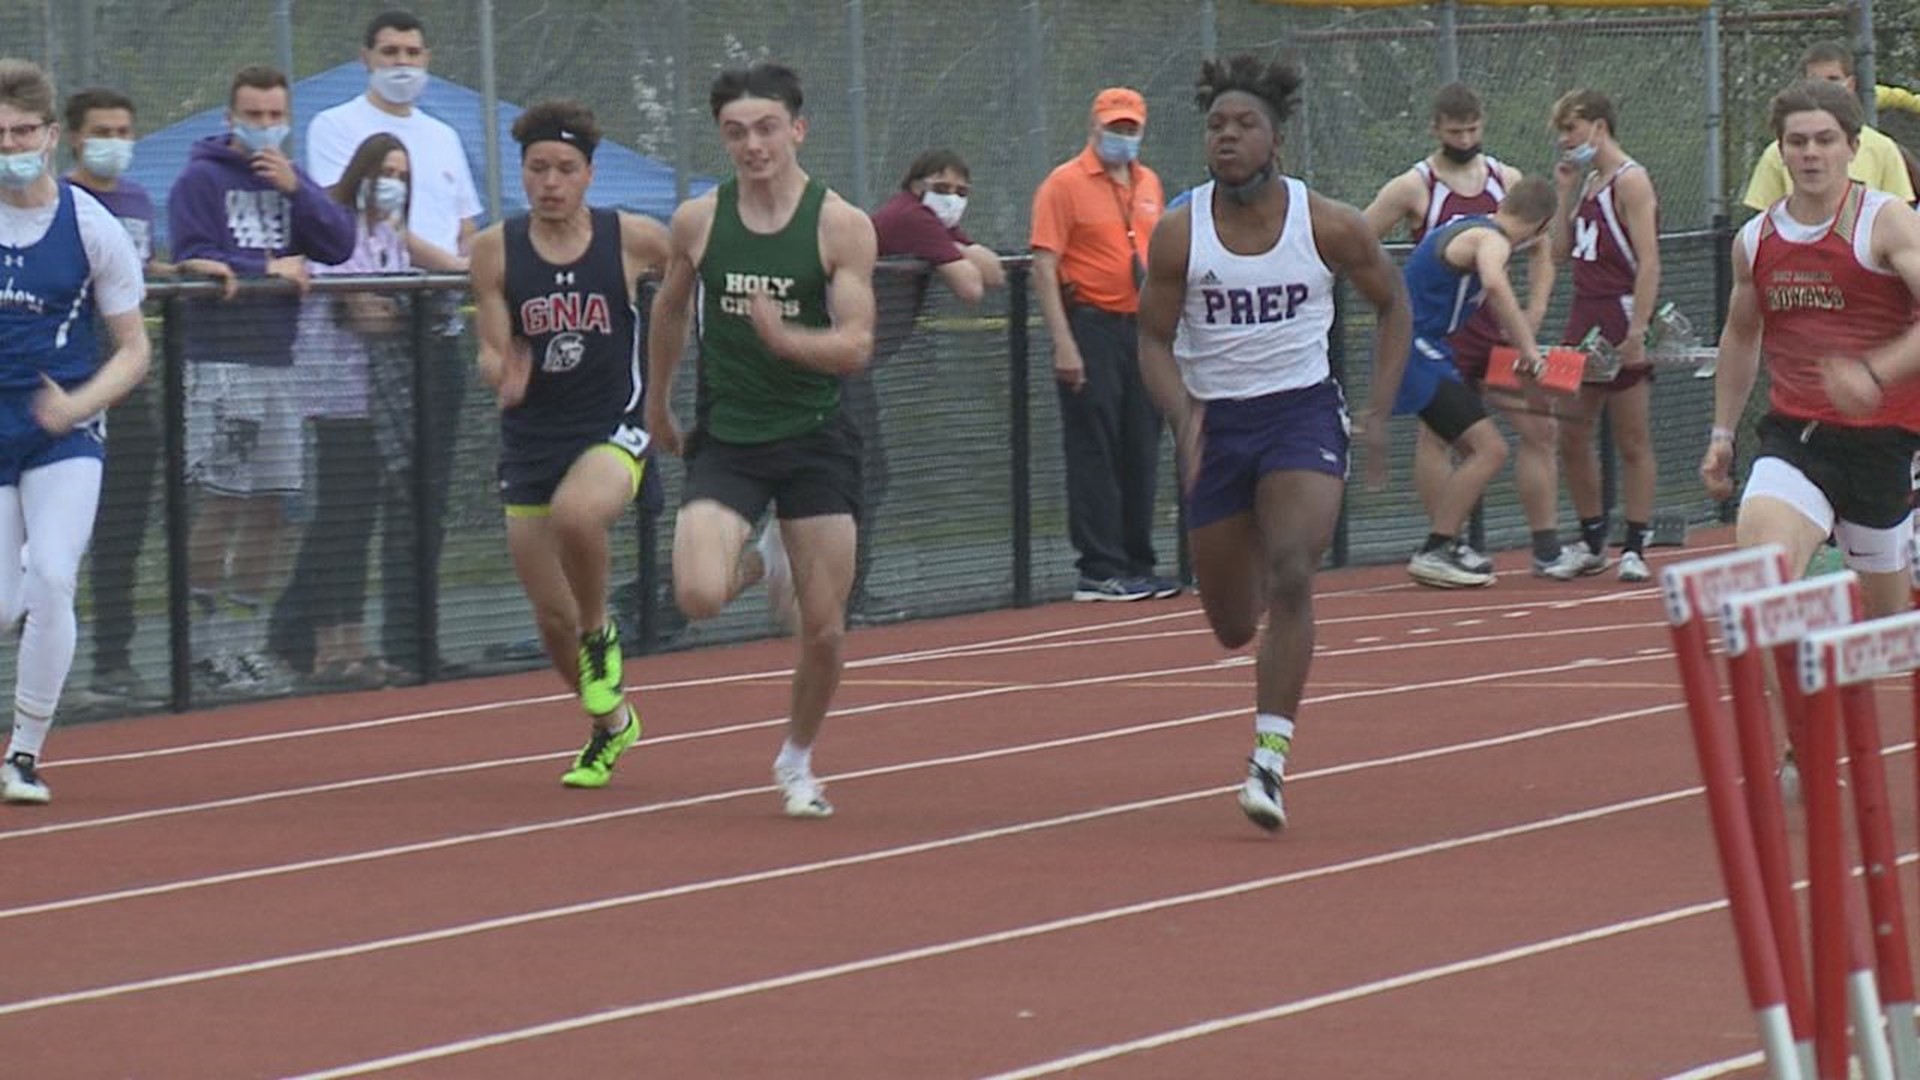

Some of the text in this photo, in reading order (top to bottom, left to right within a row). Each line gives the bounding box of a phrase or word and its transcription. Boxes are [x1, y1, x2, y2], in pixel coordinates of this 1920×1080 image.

[1572, 217, 1599, 261] M
[725, 273, 795, 297] HOLY
[1202, 283, 1309, 325] PREP
[521, 292, 611, 335] GNA
[720, 296, 800, 317] CRS
